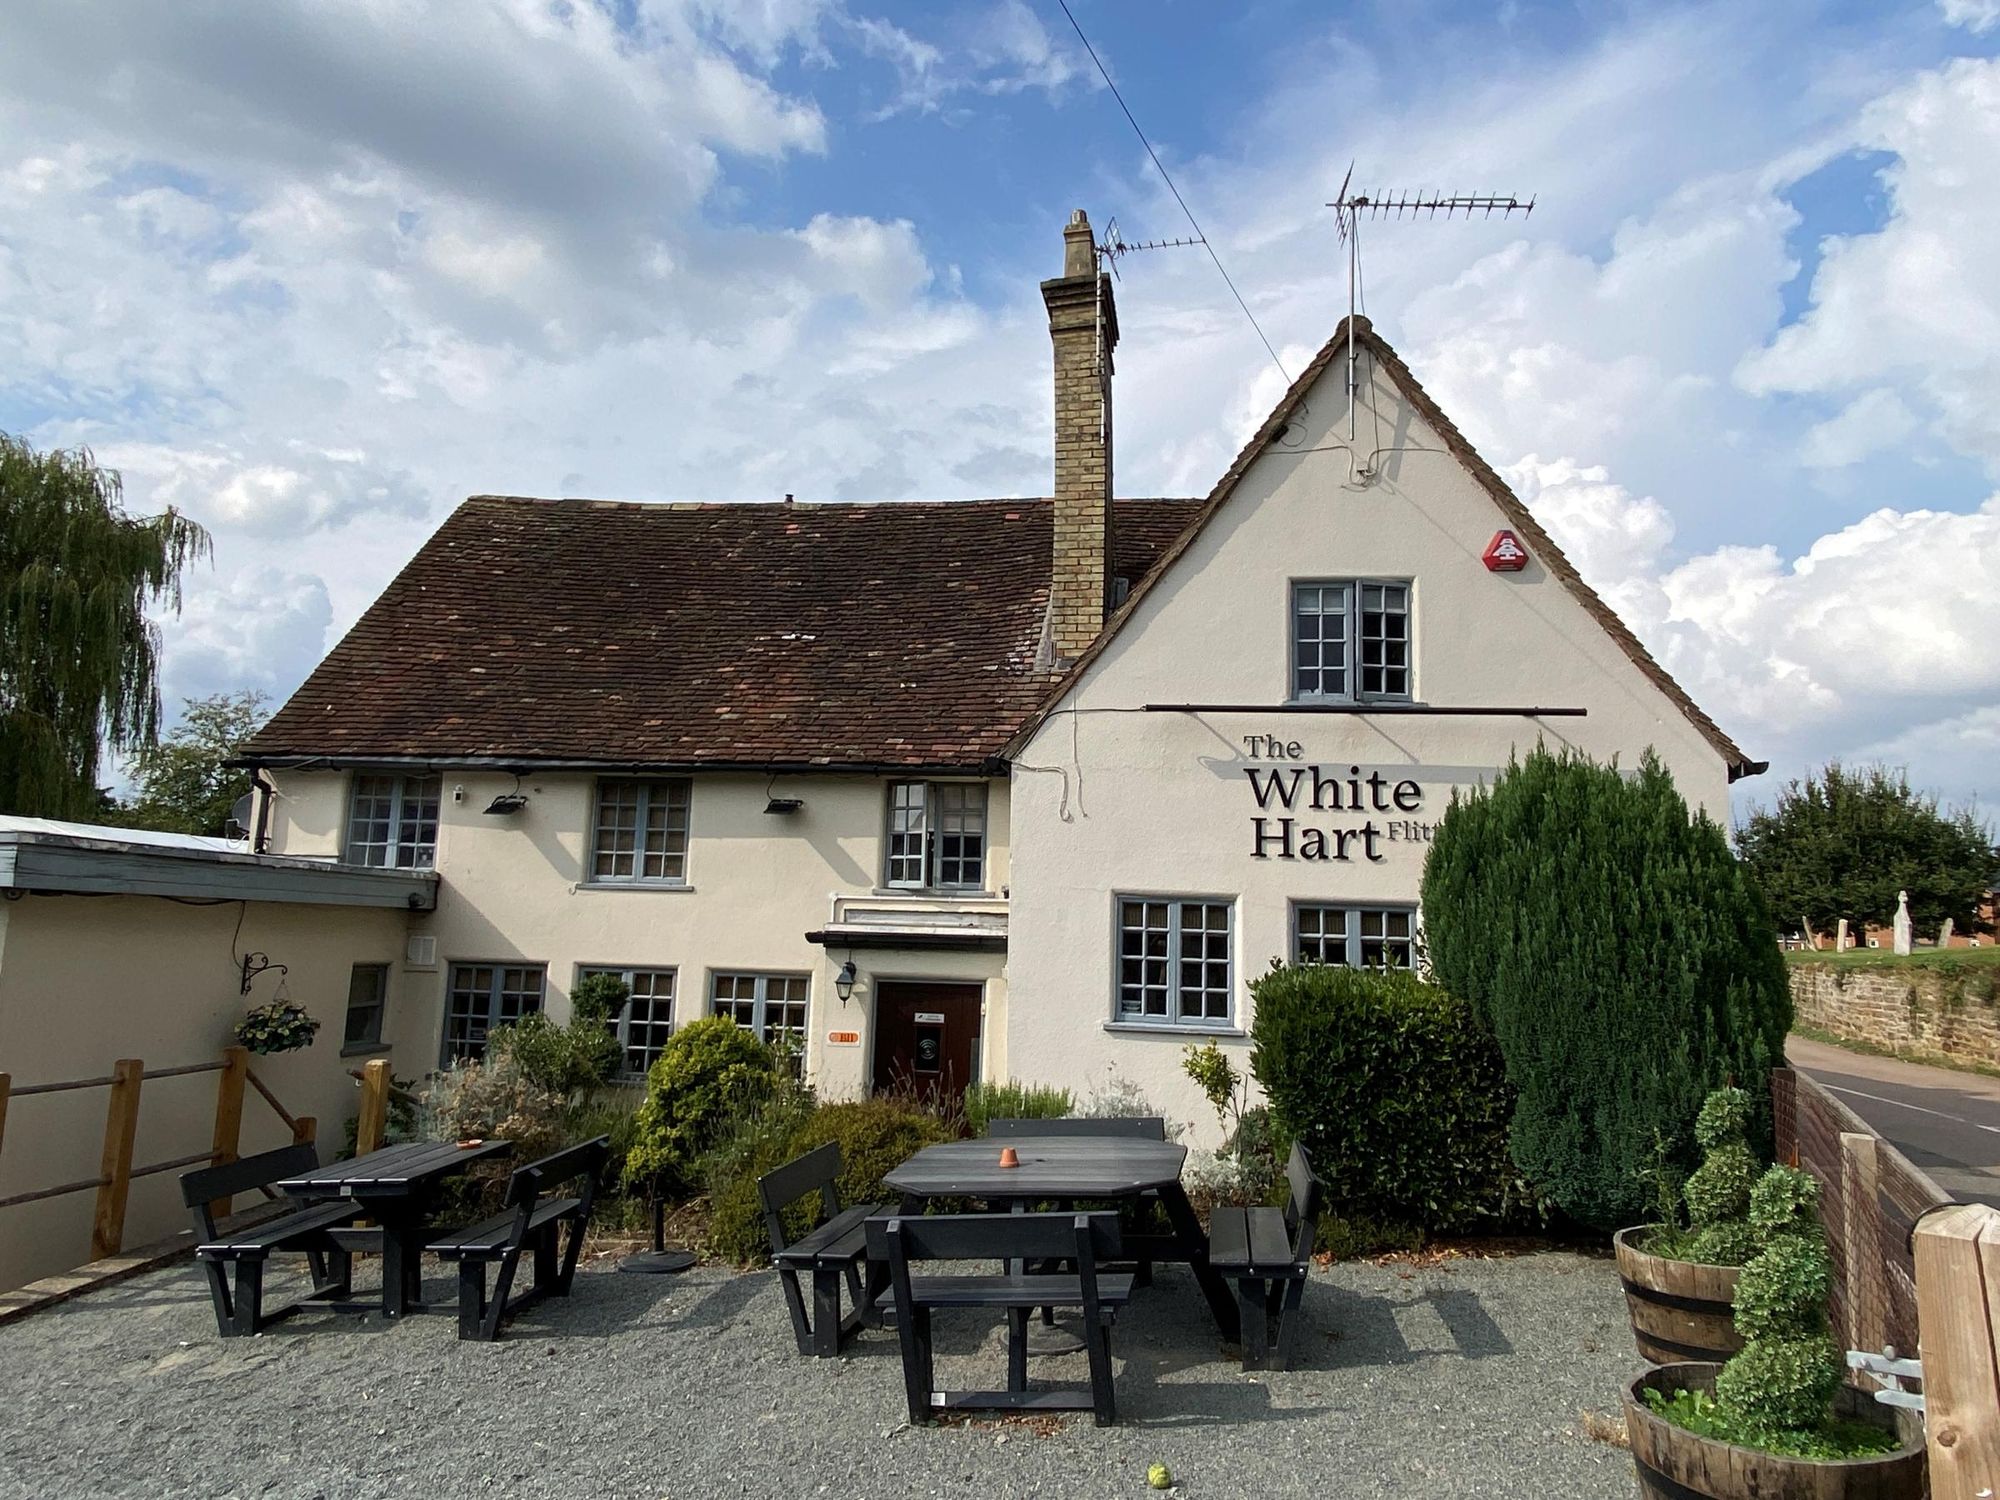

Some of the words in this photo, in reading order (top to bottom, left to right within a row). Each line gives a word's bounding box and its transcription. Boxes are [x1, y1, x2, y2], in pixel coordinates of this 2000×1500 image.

[1243, 734, 1303, 759] The
[1243, 765, 1422, 812] White
[1250, 817, 1383, 861] Hart
